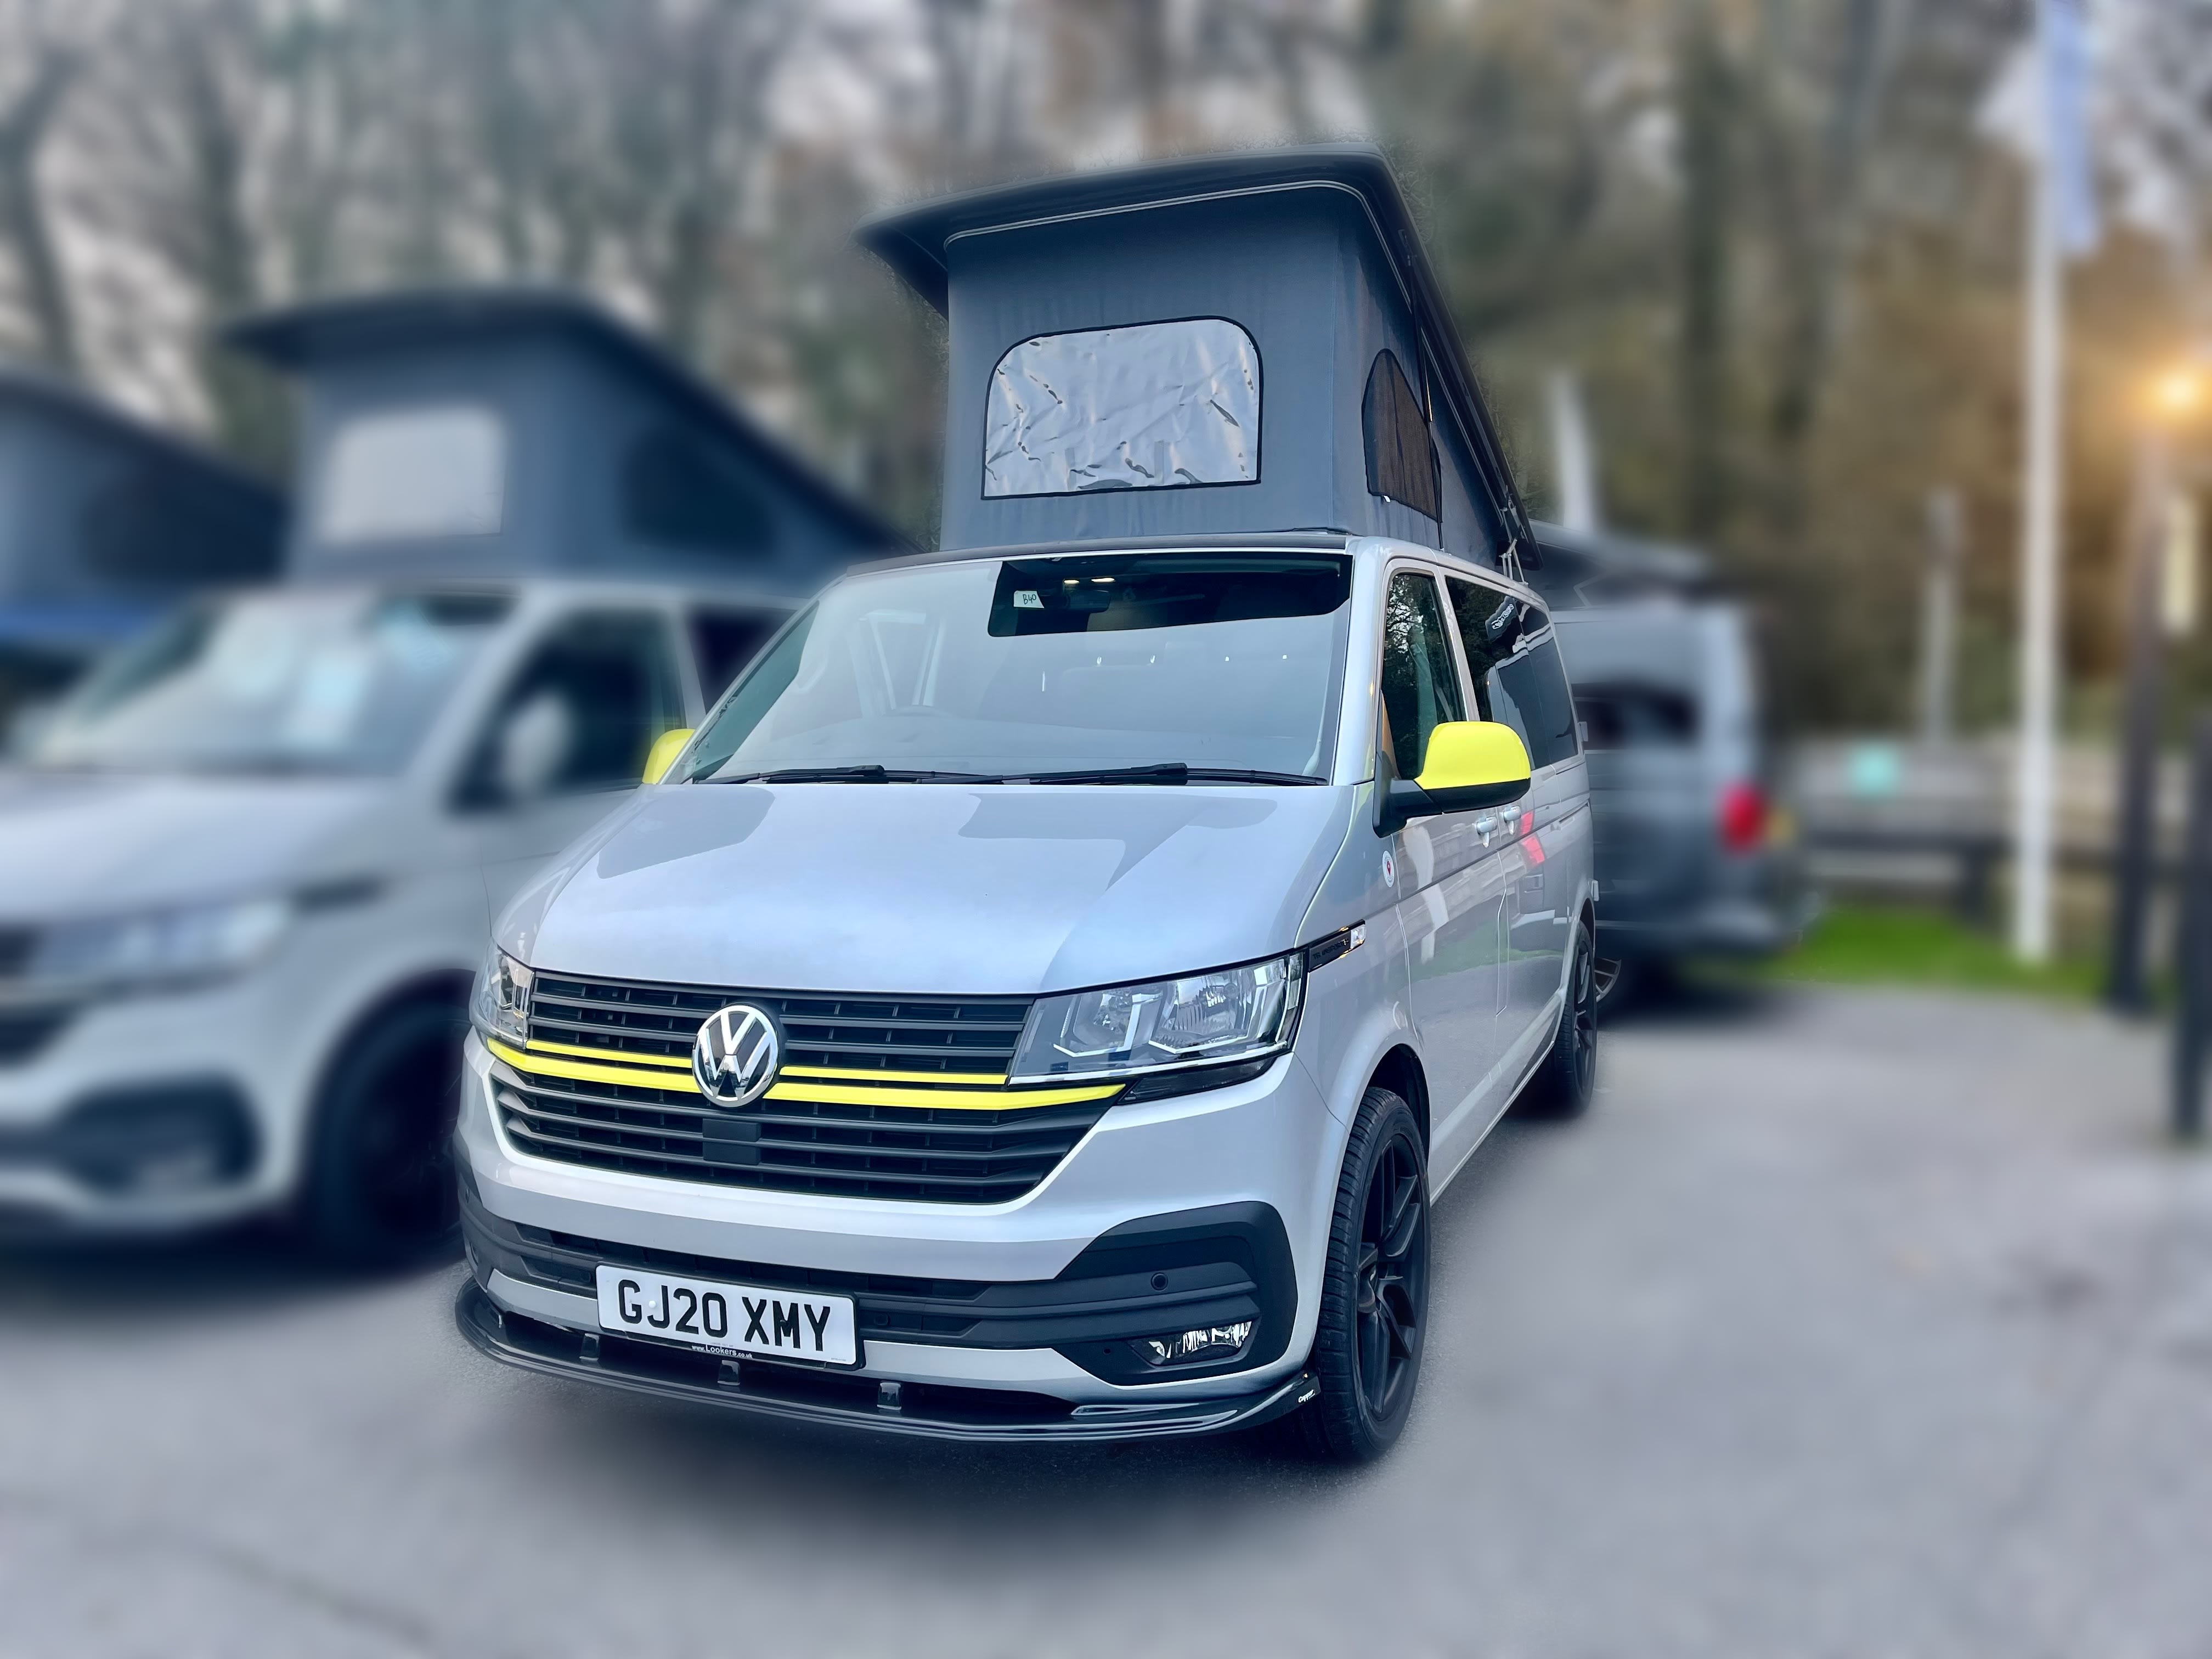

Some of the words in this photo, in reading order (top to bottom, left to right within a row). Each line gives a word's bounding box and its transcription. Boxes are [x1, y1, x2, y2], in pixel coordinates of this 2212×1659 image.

[1023, 594, 1037, 605] B40
[618, 1279, 728, 1338] GJ20
[742, 1296, 831, 1352] XMY
[691, 1344, 753, 1359] www.Lookers.co.uk
